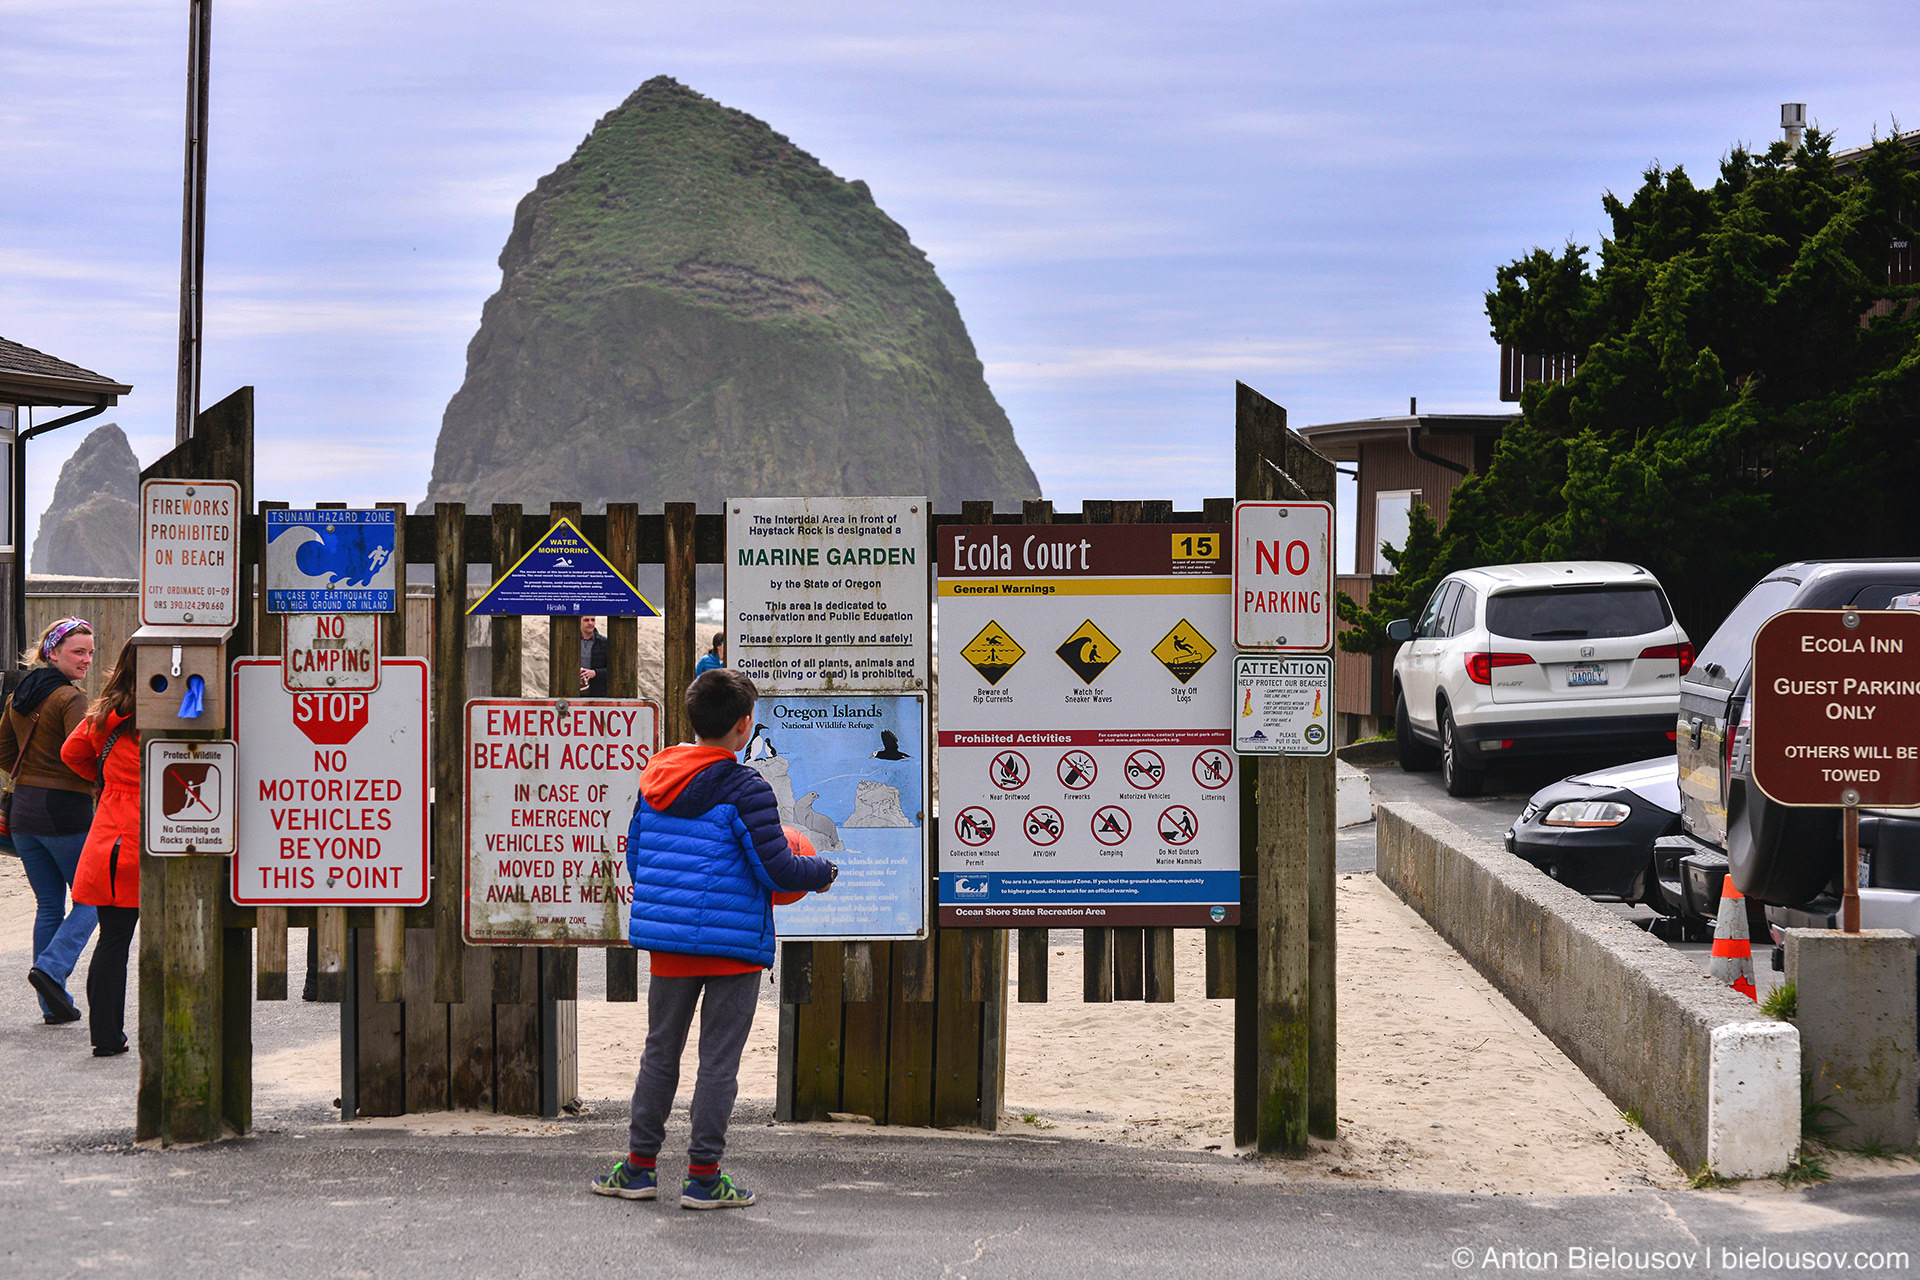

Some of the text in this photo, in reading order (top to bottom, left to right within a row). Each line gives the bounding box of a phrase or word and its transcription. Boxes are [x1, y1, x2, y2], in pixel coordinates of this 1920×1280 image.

[153, 499, 228, 516] FIREWORKS
[272, 512, 390, 522] TSUNAMI HAZARD ZONE
[753, 515, 897, 525] The Intertidal Area in front of
[152, 524, 229, 541] PROHIBITED
[750, 526, 794, 537] Haystack
[798, 525, 822, 535] Rock
[826, 526, 834, 534] is
[838, 525, 892, 536] designated
[954, 535, 1091, 570] Ecola Court
[1181, 537, 1212, 556] 15
[156, 549, 224, 566] ON BEACH
[739, 548, 915, 566] MARINE GARDEN
[1256, 540, 1309, 575] NO
[149, 586, 229, 596] CITY ORDINANCE 01-09
[771, 579, 881, 590] by the State of Oregon
[954, 584, 1055, 595] General Warnings
[274, 591, 390, 601] IN CASE OF EARTHQUAKE GO
[1245, 591, 1320, 613] PARKING
[276, 601, 387, 611] TO HIGH GROUND OR INLAND
[765, 602, 786, 611] This
[814, 601, 822, 610] is
[826, 601, 873, 610] dedicated
[877, 601, 887, 610] to
[739, 612, 912, 621] Conservation and Public Education
[316, 616, 344, 639] NO
[739, 634, 913, 645] Please explore it gently and safely!
[292, 649, 370, 673] CAMPING
[738, 658, 914, 669] Collection of all plants, animals and
[1241, 663, 1325, 675] ATTENTION
[743, 669, 914, 681] hells (living or dead) is prohibited.
[1239, 679, 1254, 687] HELP
[1300, 679, 1328, 688] BEACHES
[1171, 688, 1186, 696] Stay
[1176, 694, 1191, 703] Logs
[297, 694, 365, 722] STOP
[773, 704, 882, 721] Oregon Islands
[487, 709, 637, 737] EMERGENCY
[782, 721, 814, 729] National
[848, 721, 874, 729] Refuge
[954, 733, 1072, 743] Prohibited Activities
[164, 751, 221, 760] Protect Wildlife
[315, 750, 347, 772] NO
[474, 743, 651, 771] BEACH ACCESS
[1785, 746, 1918, 759] OTHERS WILL BE
[260, 779, 401, 801] MOTORIZED
[515, 784, 608, 803] IN CASE OF
[270, 808, 391, 830] VEHICLES
[512, 809, 611, 828] EMERGENCY
[163, 825, 173, 833] No
[176, 825, 208, 835] Climbing
[160, 836, 182, 844] Rocks
[196, 836, 222, 844] Islands
[280, 837, 381, 859] BEYOND
[486, 835, 627, 852] VEHICLES WILL B
[258, 867, 403, 888] THIS POINT
[499, 860, 622, 878] MOVED BY ANY
[487, 886, 634, 903] AVAILABLE MEANS
